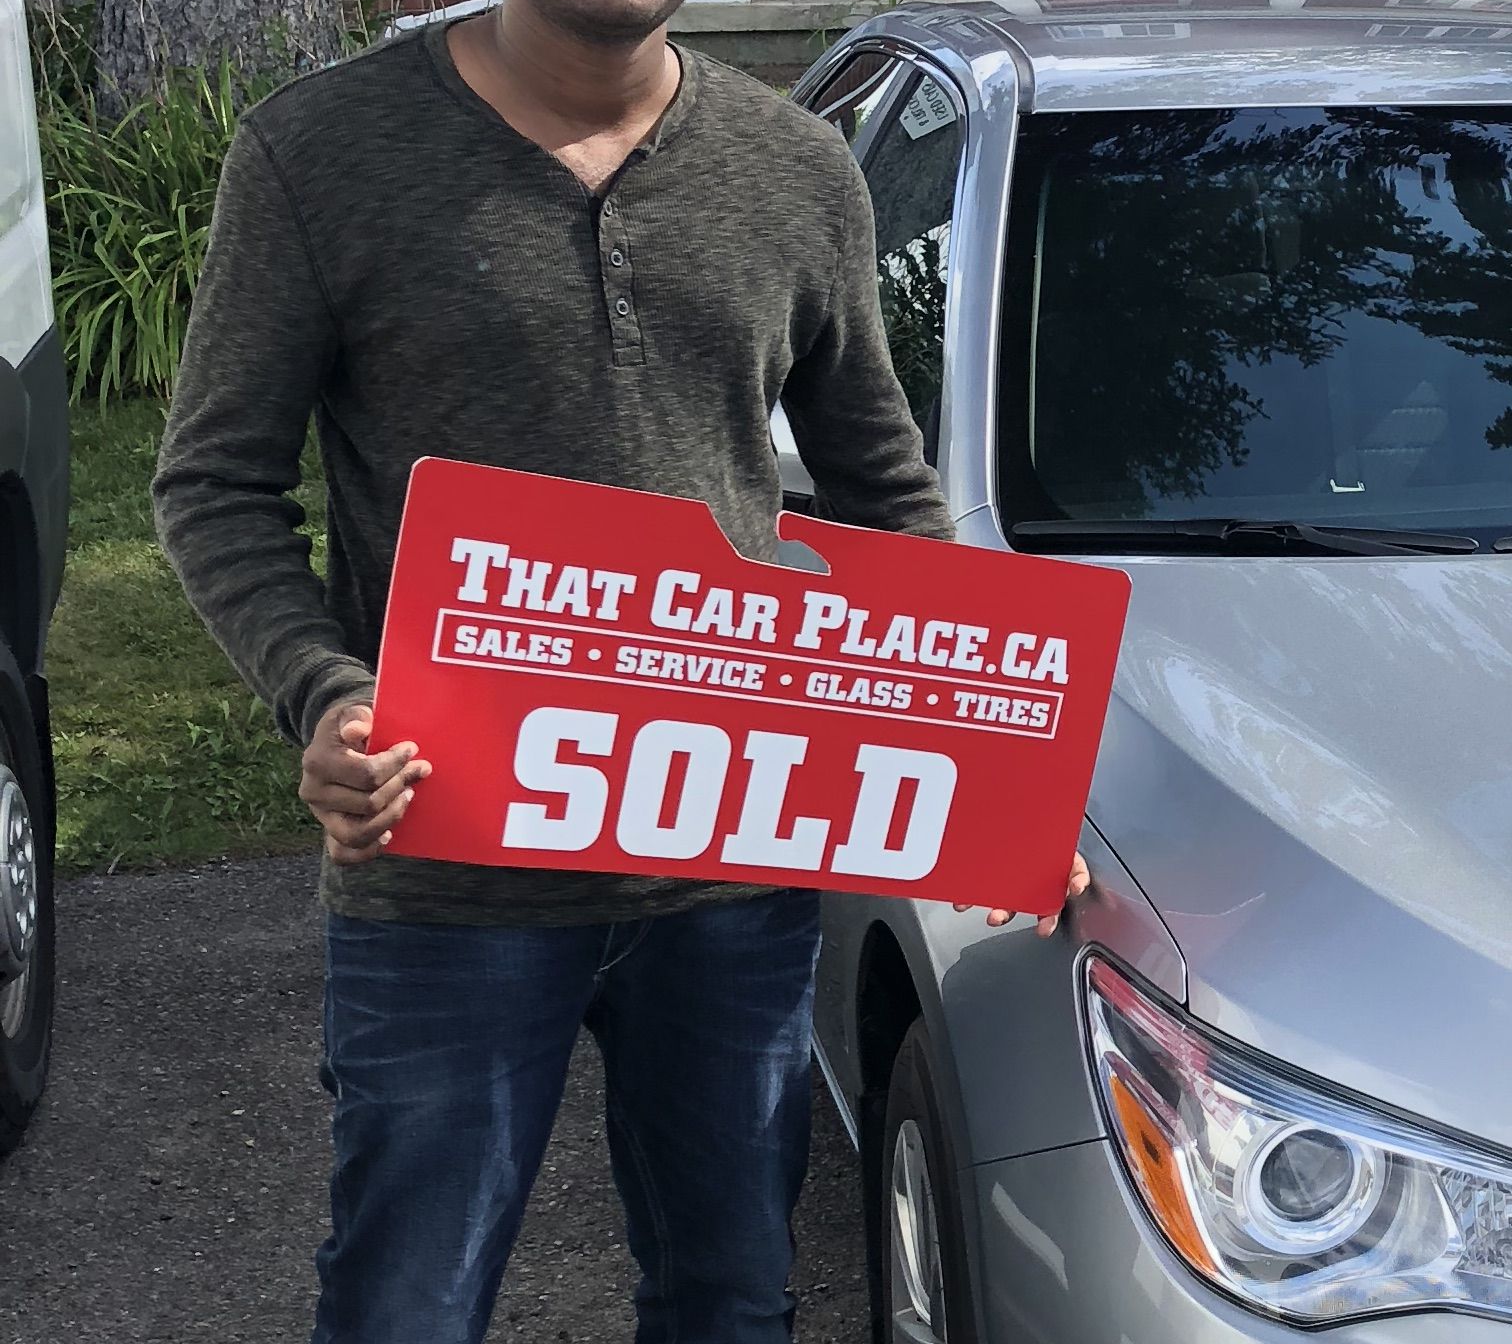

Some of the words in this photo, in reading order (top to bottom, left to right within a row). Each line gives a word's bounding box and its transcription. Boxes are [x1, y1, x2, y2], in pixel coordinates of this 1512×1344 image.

[450, 537, 638, 622] THAT
[650, 568, 780, 644] CAR
[793, 590, 1070, 685] PLACE.CA
[453, 624, 574, 666] SALES
[615, 645, 767, 691] SERVICE
[805, 671, 914, 710] GLASS
[953, 690, 1051, 728] TIRES
[502, 706, 958, 881] SOLD
